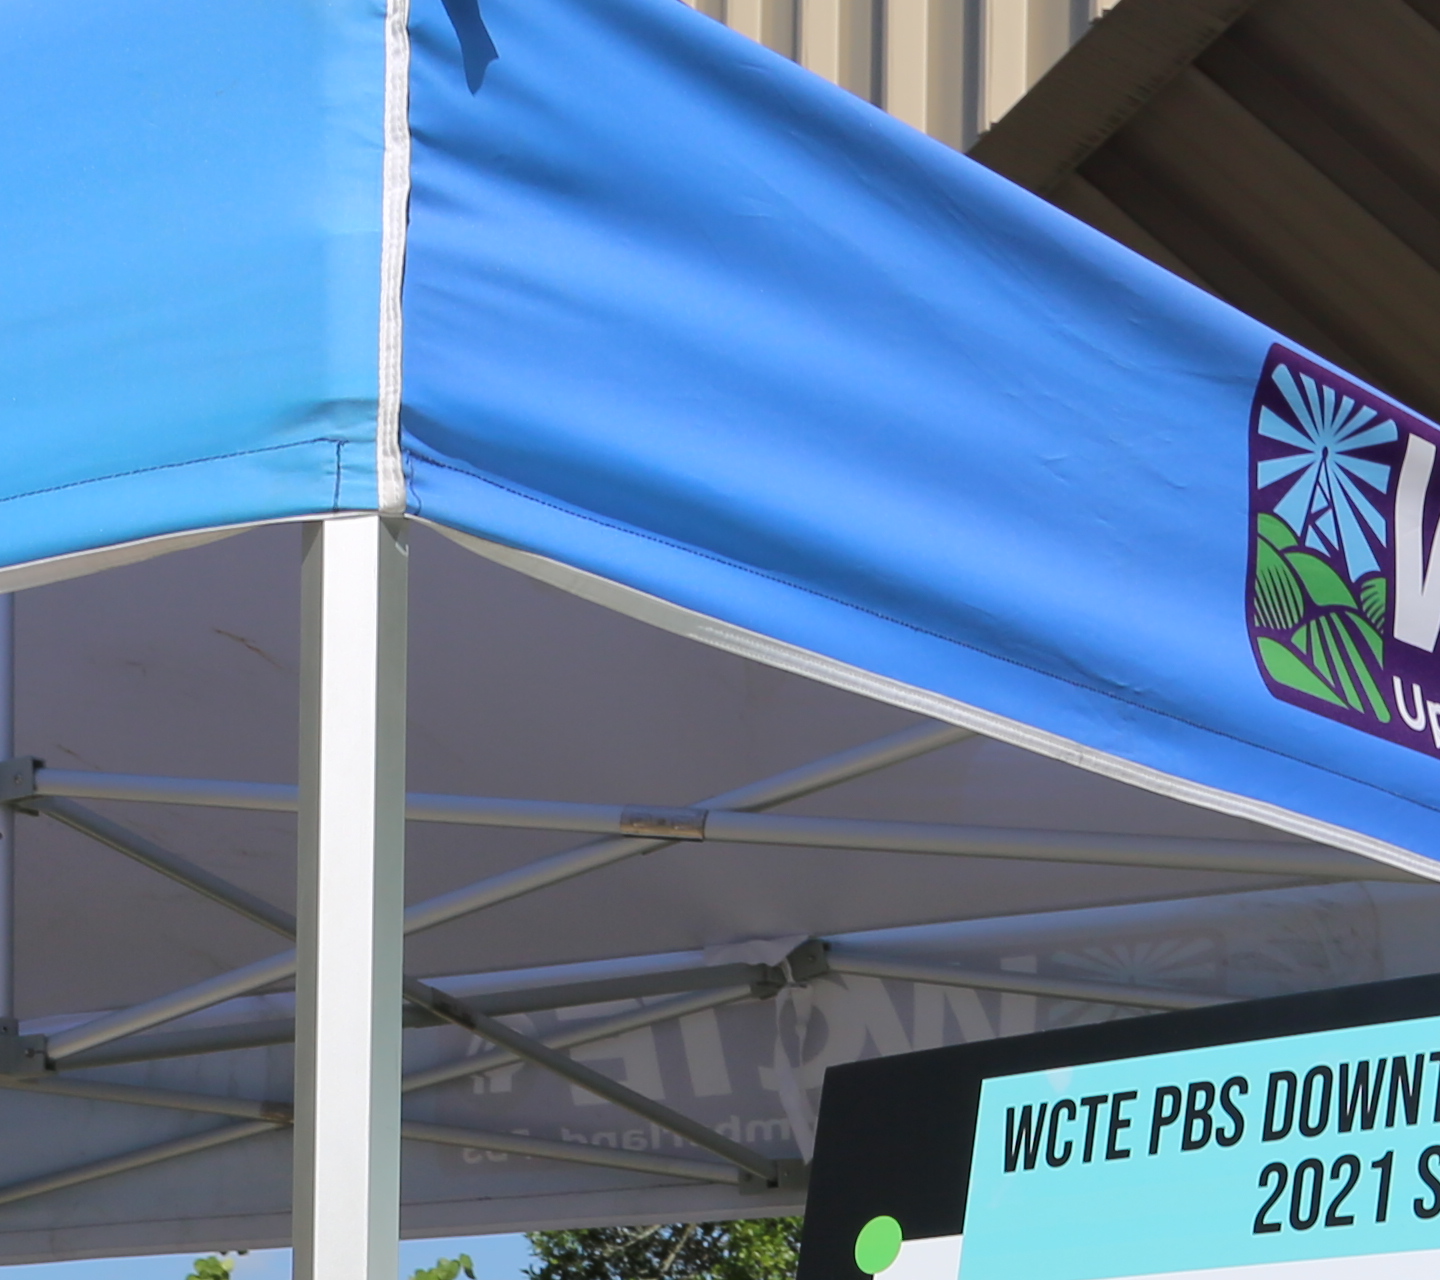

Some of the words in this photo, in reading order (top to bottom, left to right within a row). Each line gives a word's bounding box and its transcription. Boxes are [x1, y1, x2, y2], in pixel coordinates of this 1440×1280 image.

[1002, 1088, 1139, 1174] WCTE
[1146, 1074, 1250, 1156] PBS
[1250, 1148, 1395, 1236] 2021
